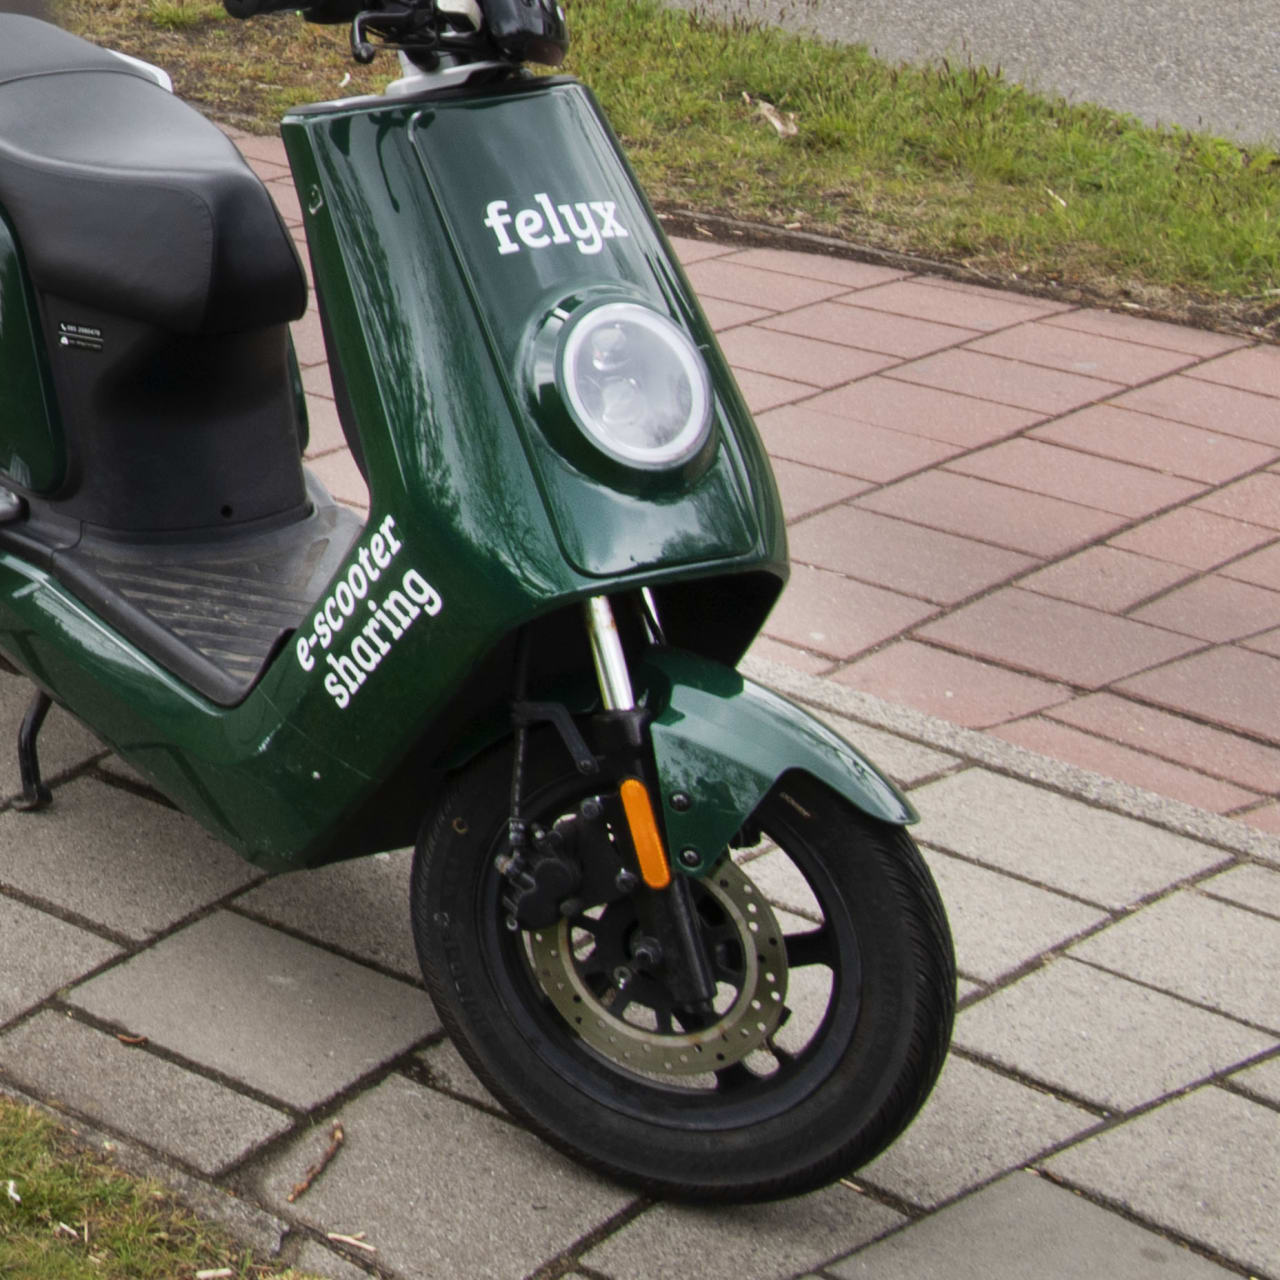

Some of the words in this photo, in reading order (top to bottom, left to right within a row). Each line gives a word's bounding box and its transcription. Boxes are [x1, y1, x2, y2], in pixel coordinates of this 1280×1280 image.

[483, 192, 629, 256] felyx
[296, 514, 402, 672] e-scooter
[323, 568, 443, 709] sharing
